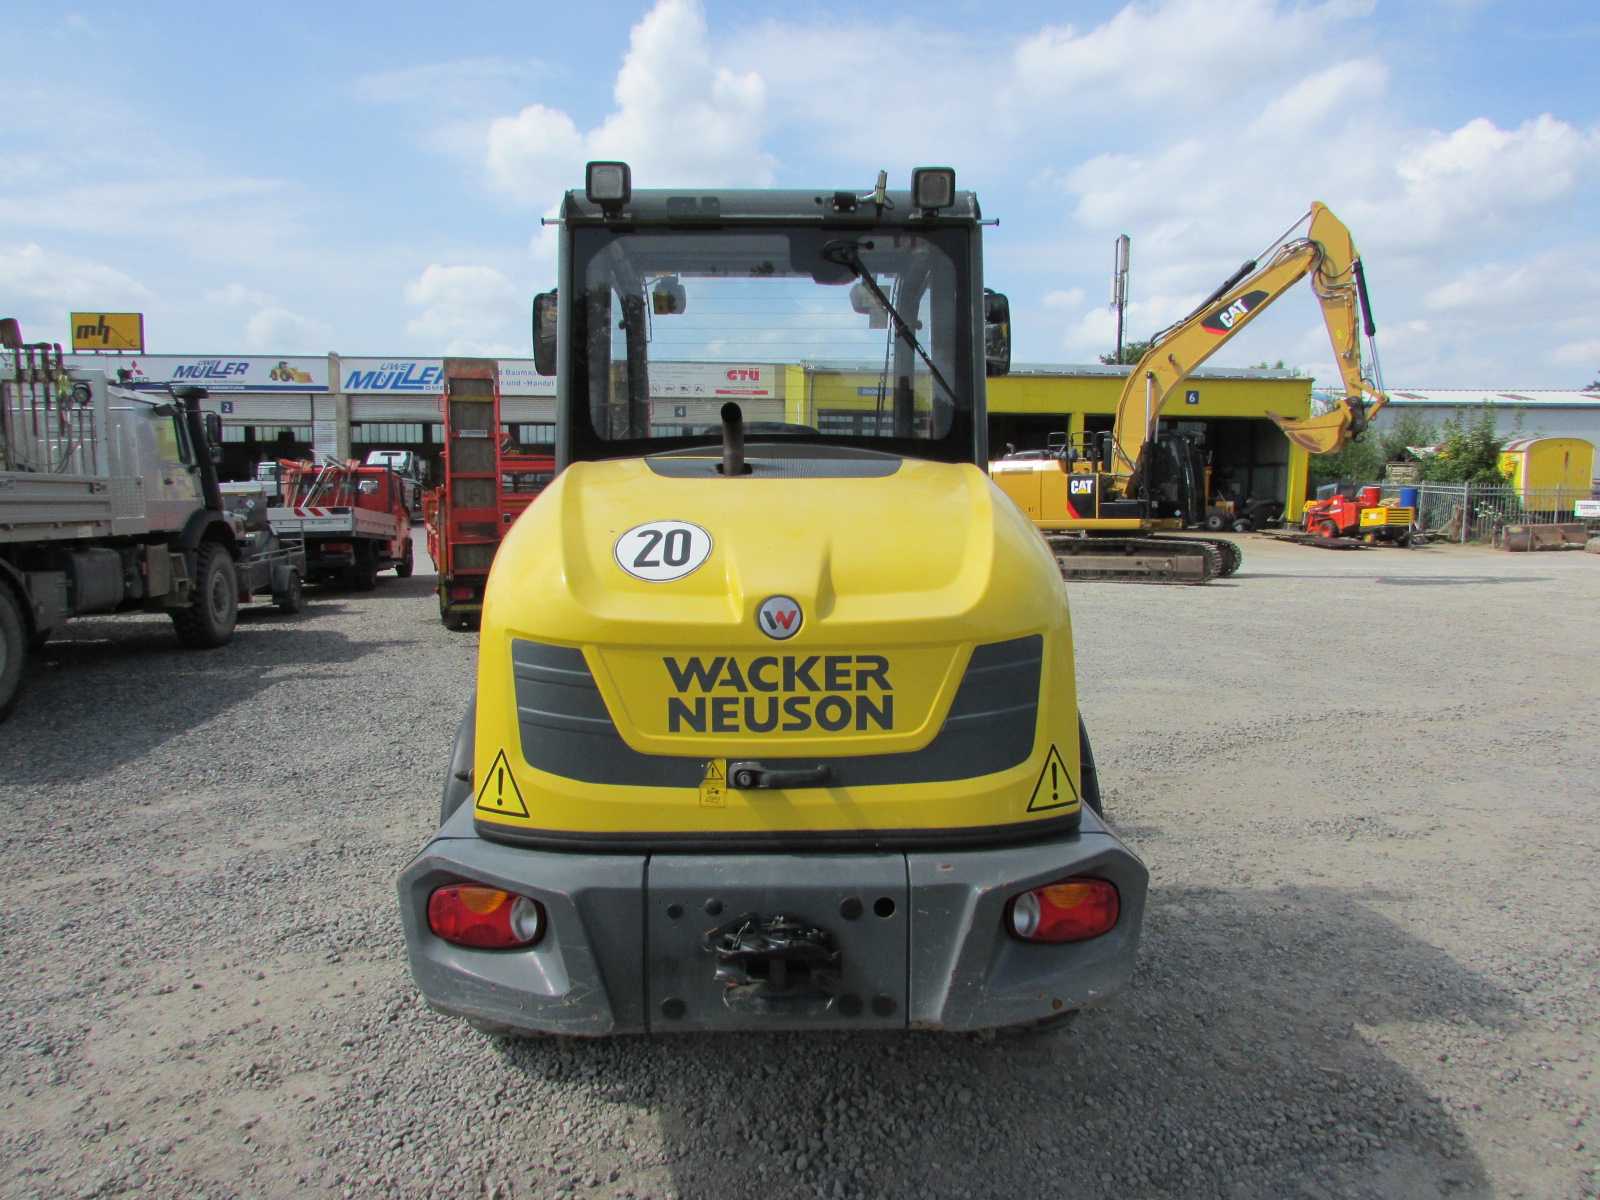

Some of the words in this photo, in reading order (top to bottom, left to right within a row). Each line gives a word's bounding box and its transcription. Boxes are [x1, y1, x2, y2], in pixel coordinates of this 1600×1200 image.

[1220, 298, 1248, 328] CAT
[172, 360, 250, 379] MÜLLER
[380, 363, 409, 371] UWE
[726, 367, 760, 381] GTÜ
[1188, 392, 1195, 403] 6
[224, 403, 230, 412] 2
[677, 407, 683, 416] 4
[1070, 480, 1093, 495] CAT
[633, 529, 692, 567] 20
[662, 655, 894, 693] WACKER
[668, 694, 894, 733] NEUSON
